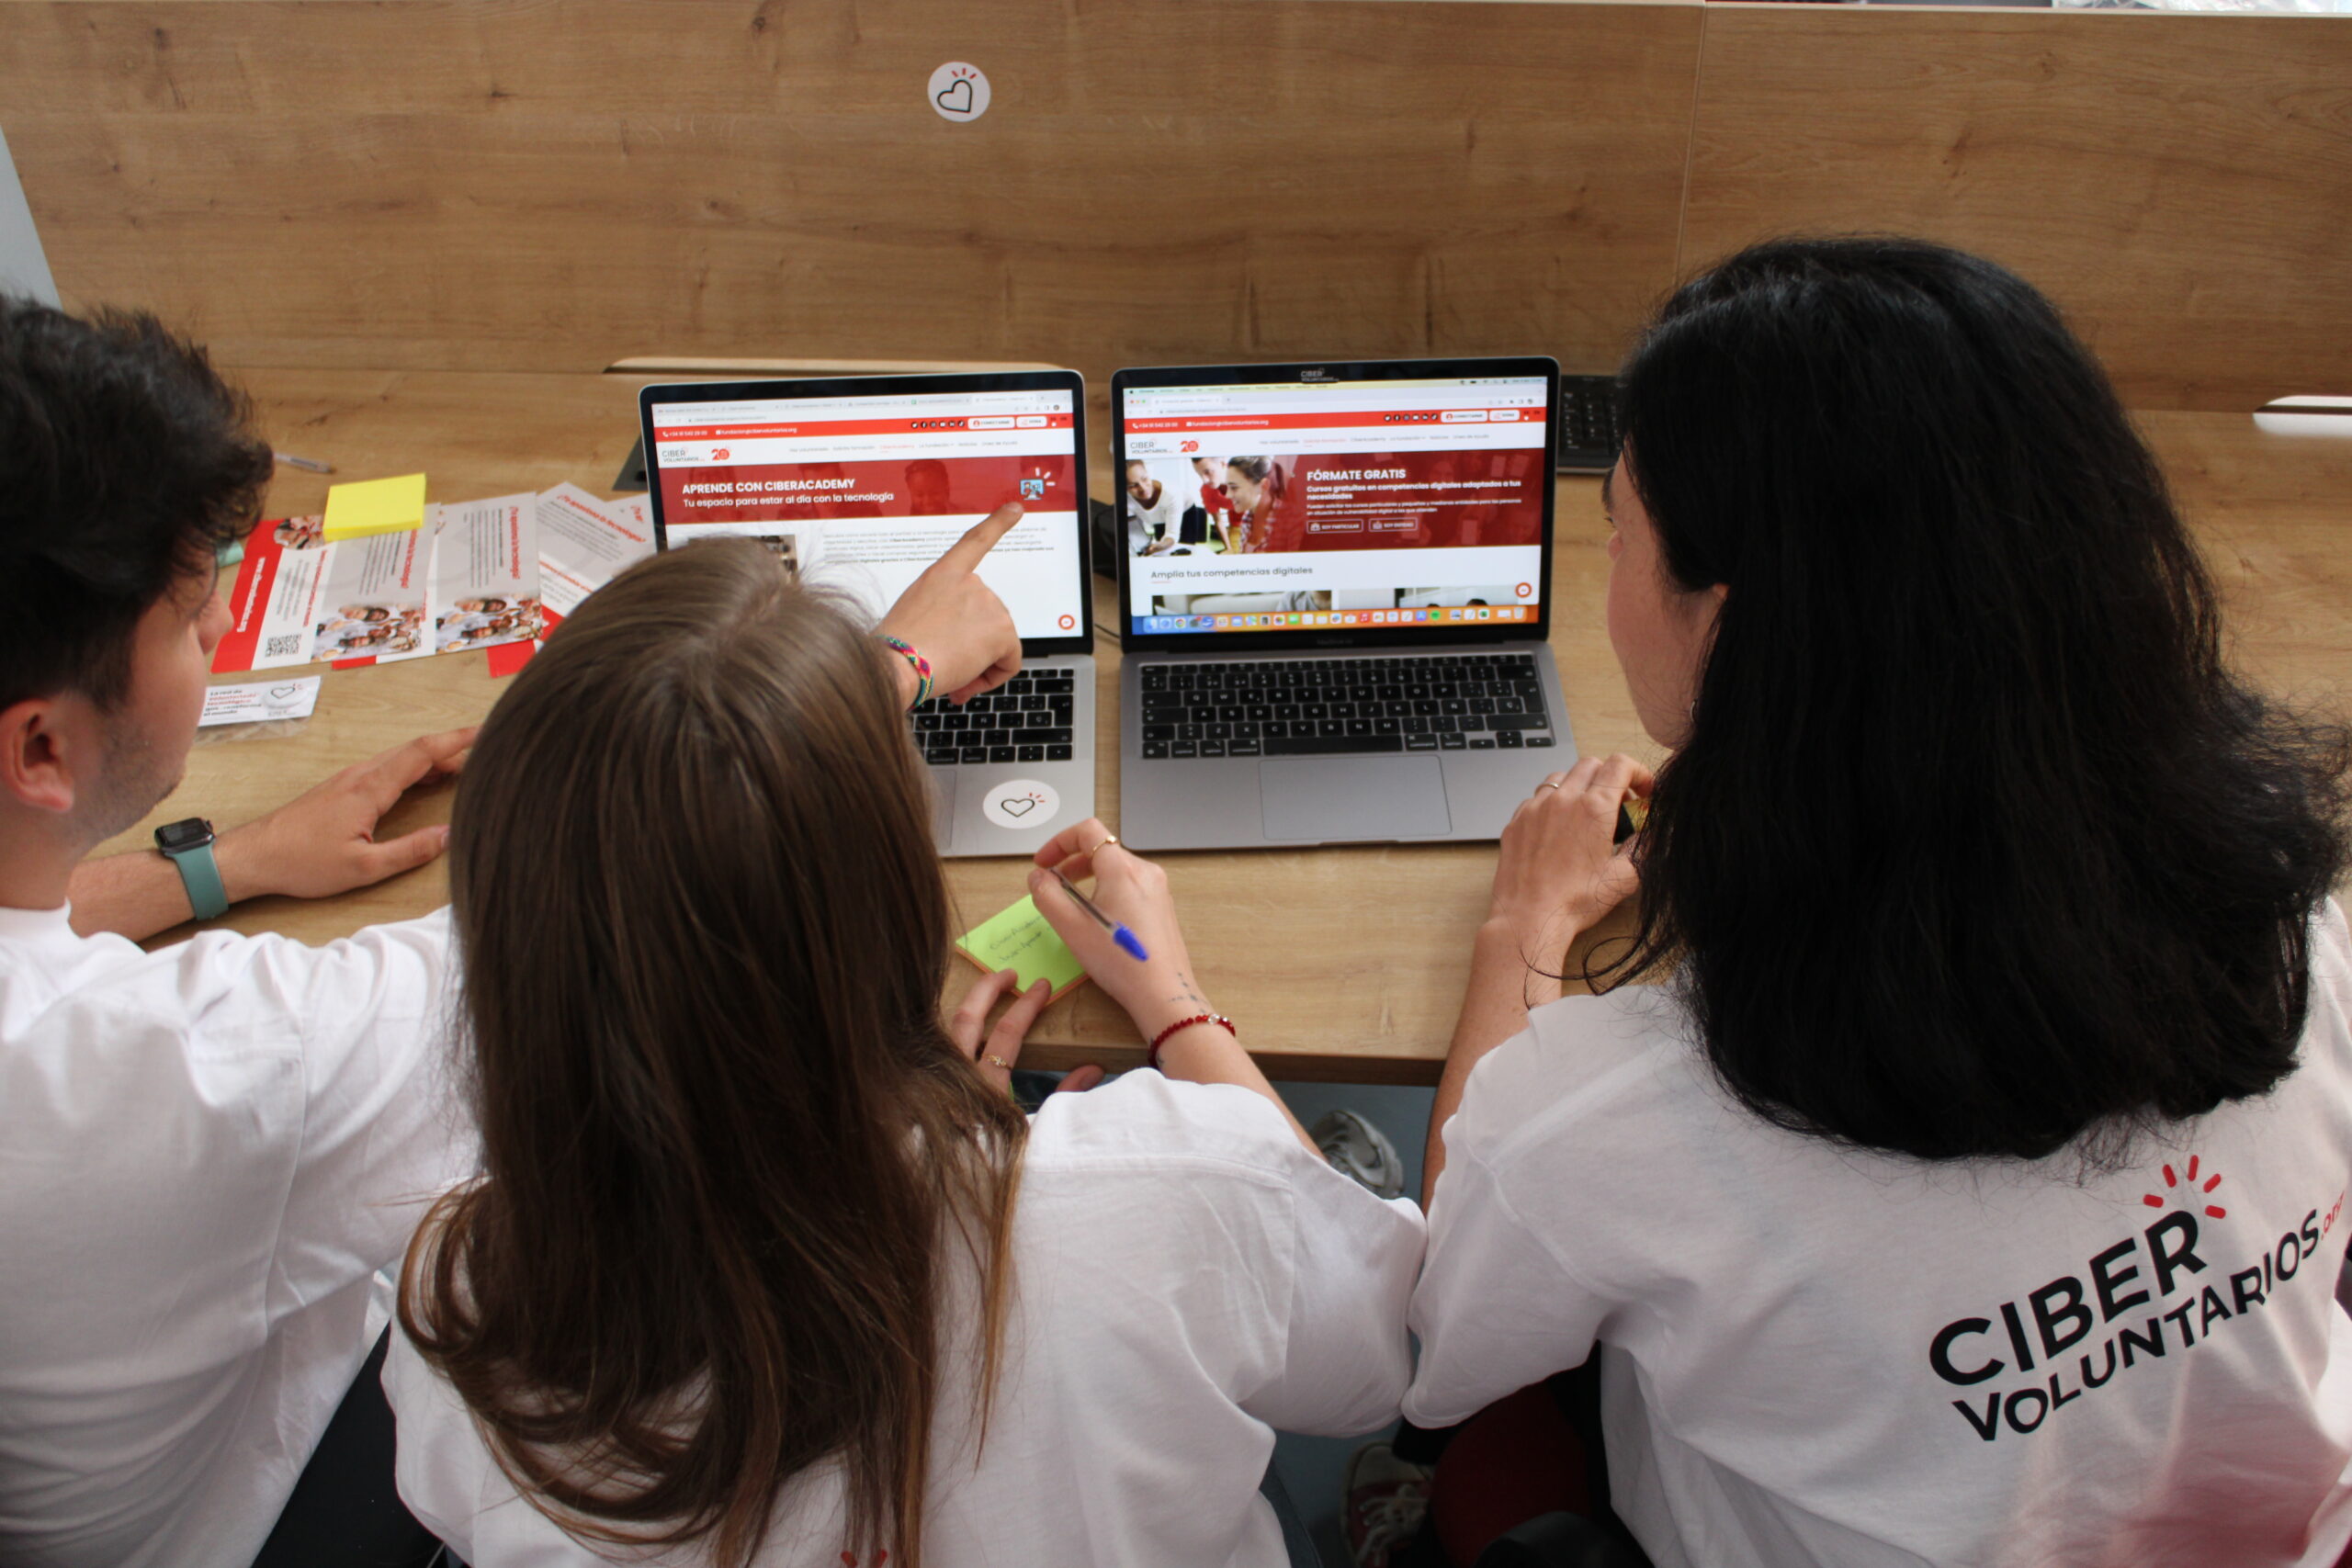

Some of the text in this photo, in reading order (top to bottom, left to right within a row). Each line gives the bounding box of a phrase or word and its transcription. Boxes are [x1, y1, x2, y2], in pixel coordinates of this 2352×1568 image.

[1306, 468, 1407, 481] FÓRMATE GRATIS
[682, 479, 855, 494] APRENDE CON CIBERACADEMY
[1334, 484, 1366, 494] gratuitos
[1378, 483, 1430, 492] competencias
[1430, 481, 1461, 491] digitales
[684, 492, 894, 509] Tu espacio para estar al día con la tecnología
[1186, 570, 1201, 579] tus
[1204, 568, 1271, 579] competencias
[1272, 566, 1313, 577] digitales
[1929, 1210, 2208, 1386] CIBER
